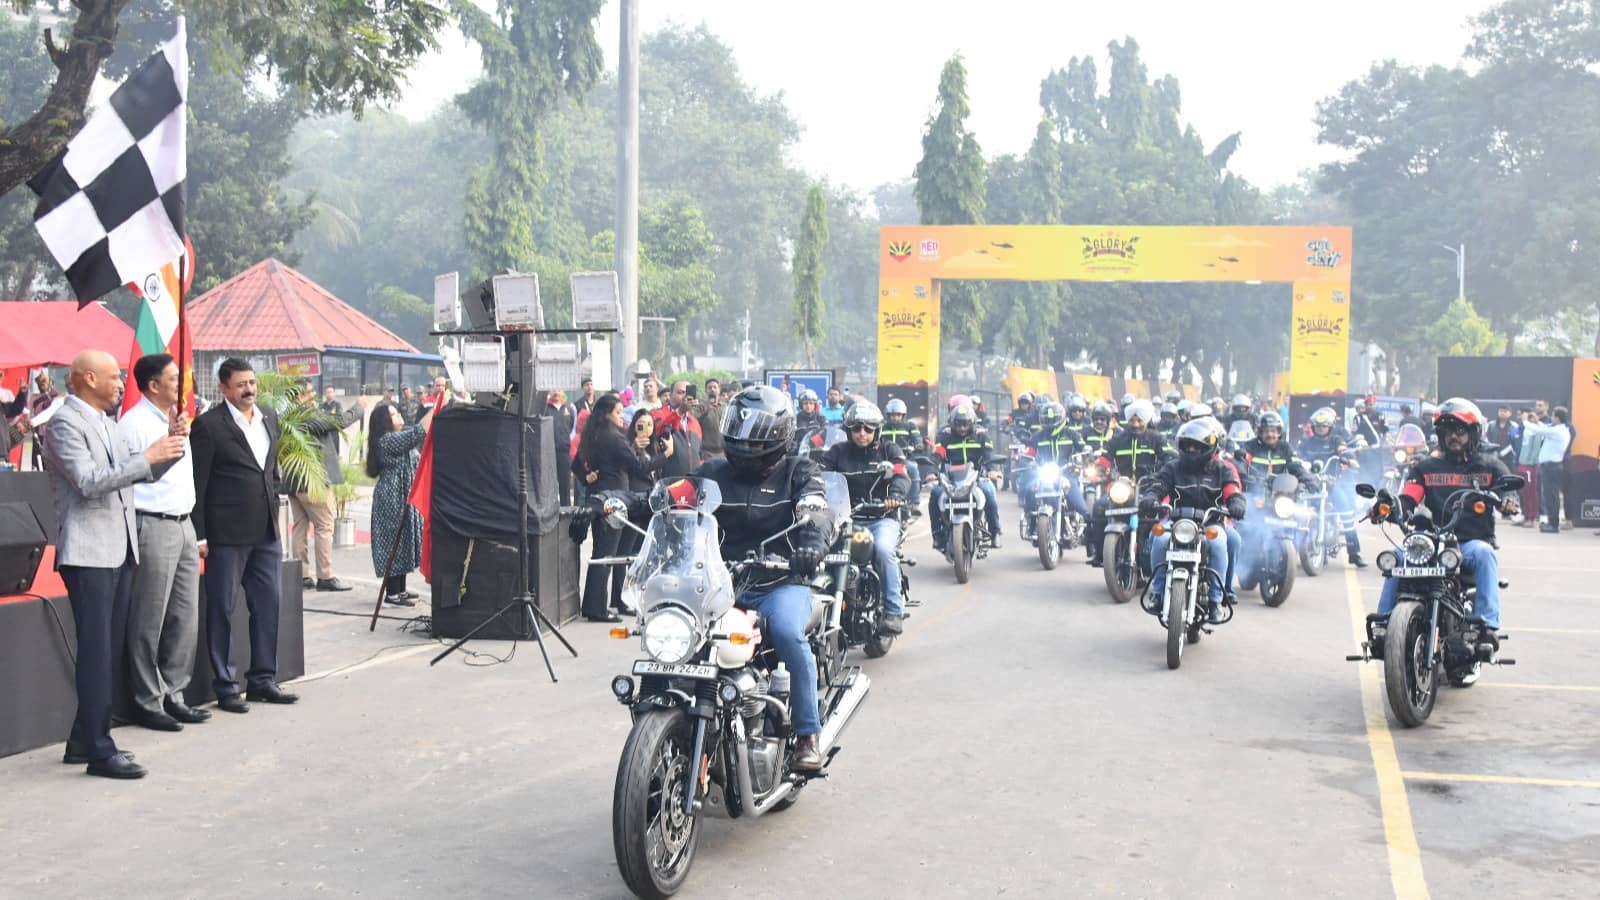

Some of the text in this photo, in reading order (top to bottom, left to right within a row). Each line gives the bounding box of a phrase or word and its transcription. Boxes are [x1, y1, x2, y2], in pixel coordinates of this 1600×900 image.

[1093, 238, 1127, 249] GLORY
[891, 312, 917, 322] GLORY
[1306, 319, 1335, 329] GLORY
[648, 663, 660, 673] 23
